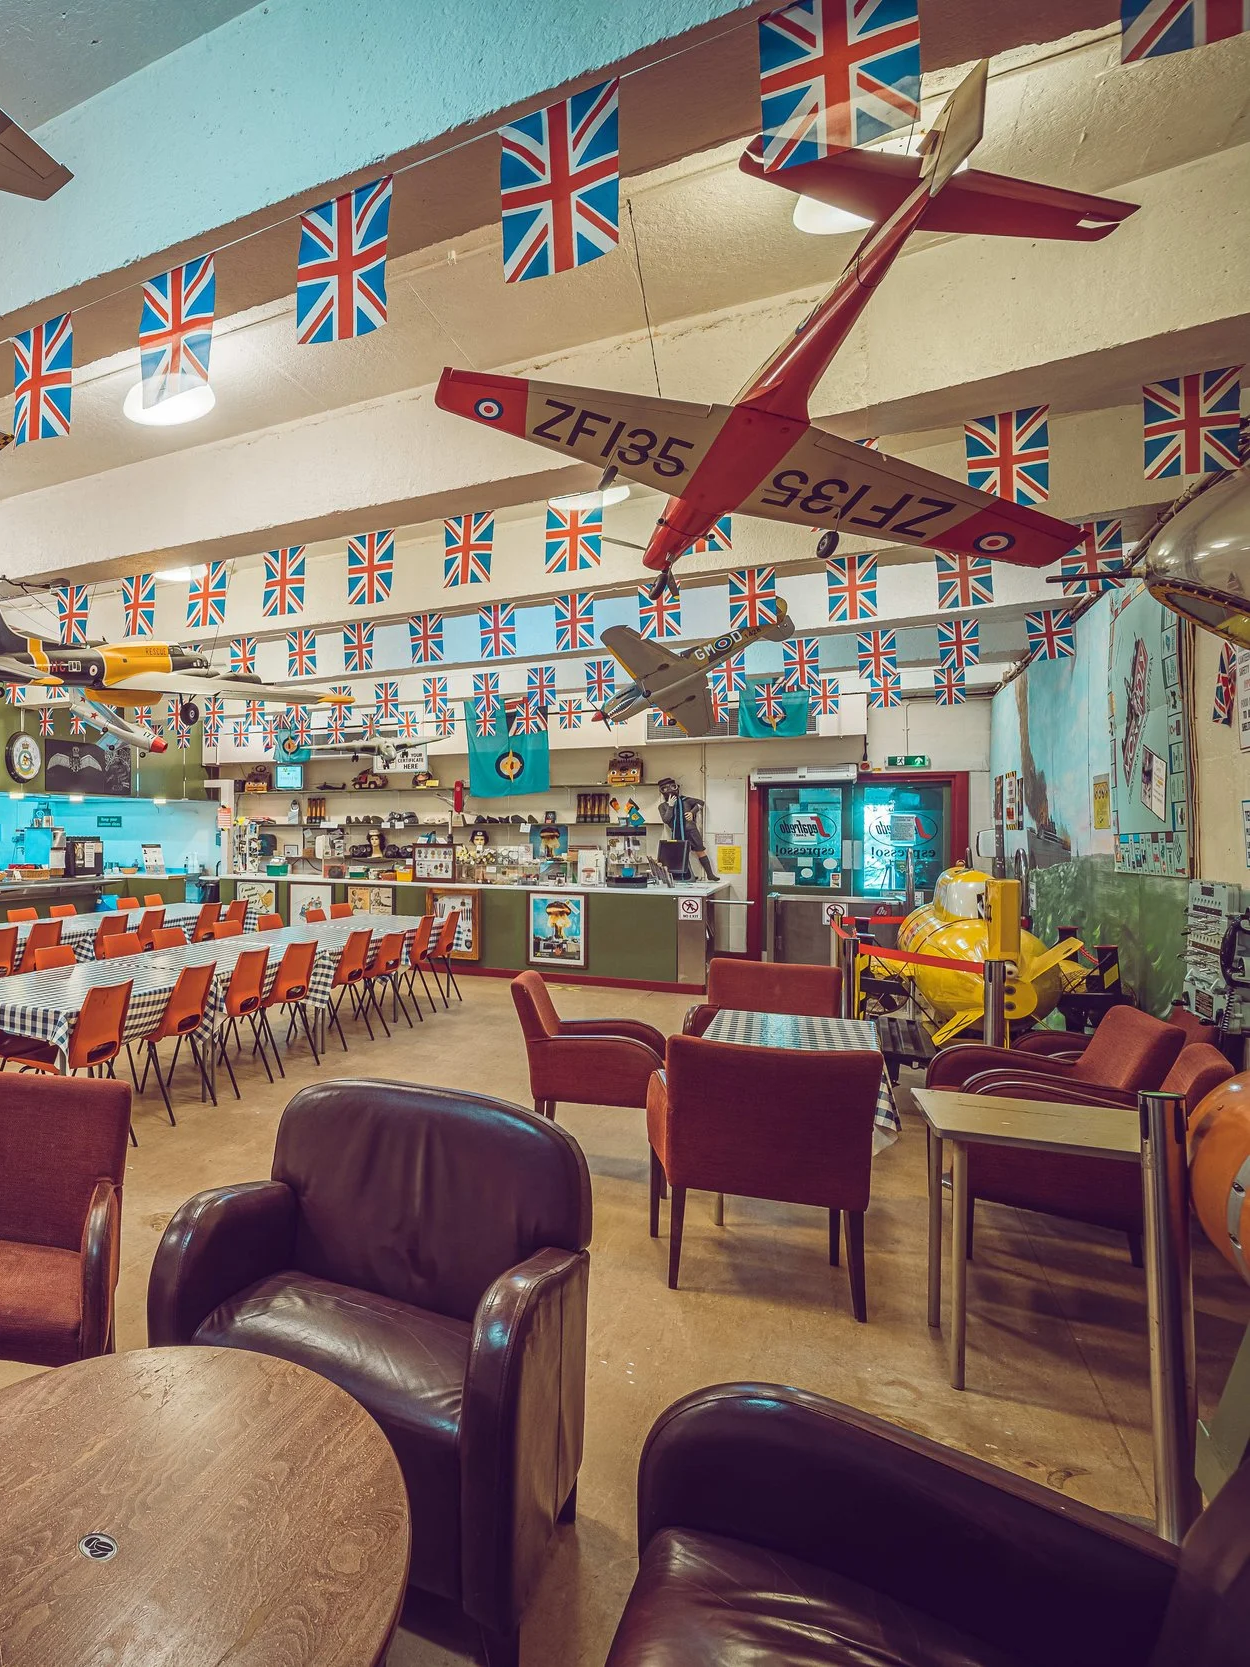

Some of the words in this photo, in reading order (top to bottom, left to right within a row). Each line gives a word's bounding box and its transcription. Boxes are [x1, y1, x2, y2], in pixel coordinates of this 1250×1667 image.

[532, 399, 694, 477] ZF135
[760, 469, 957, 538] ZF135
[694, 643, 716, 660] GM
[730, 631, 743, 643] D
